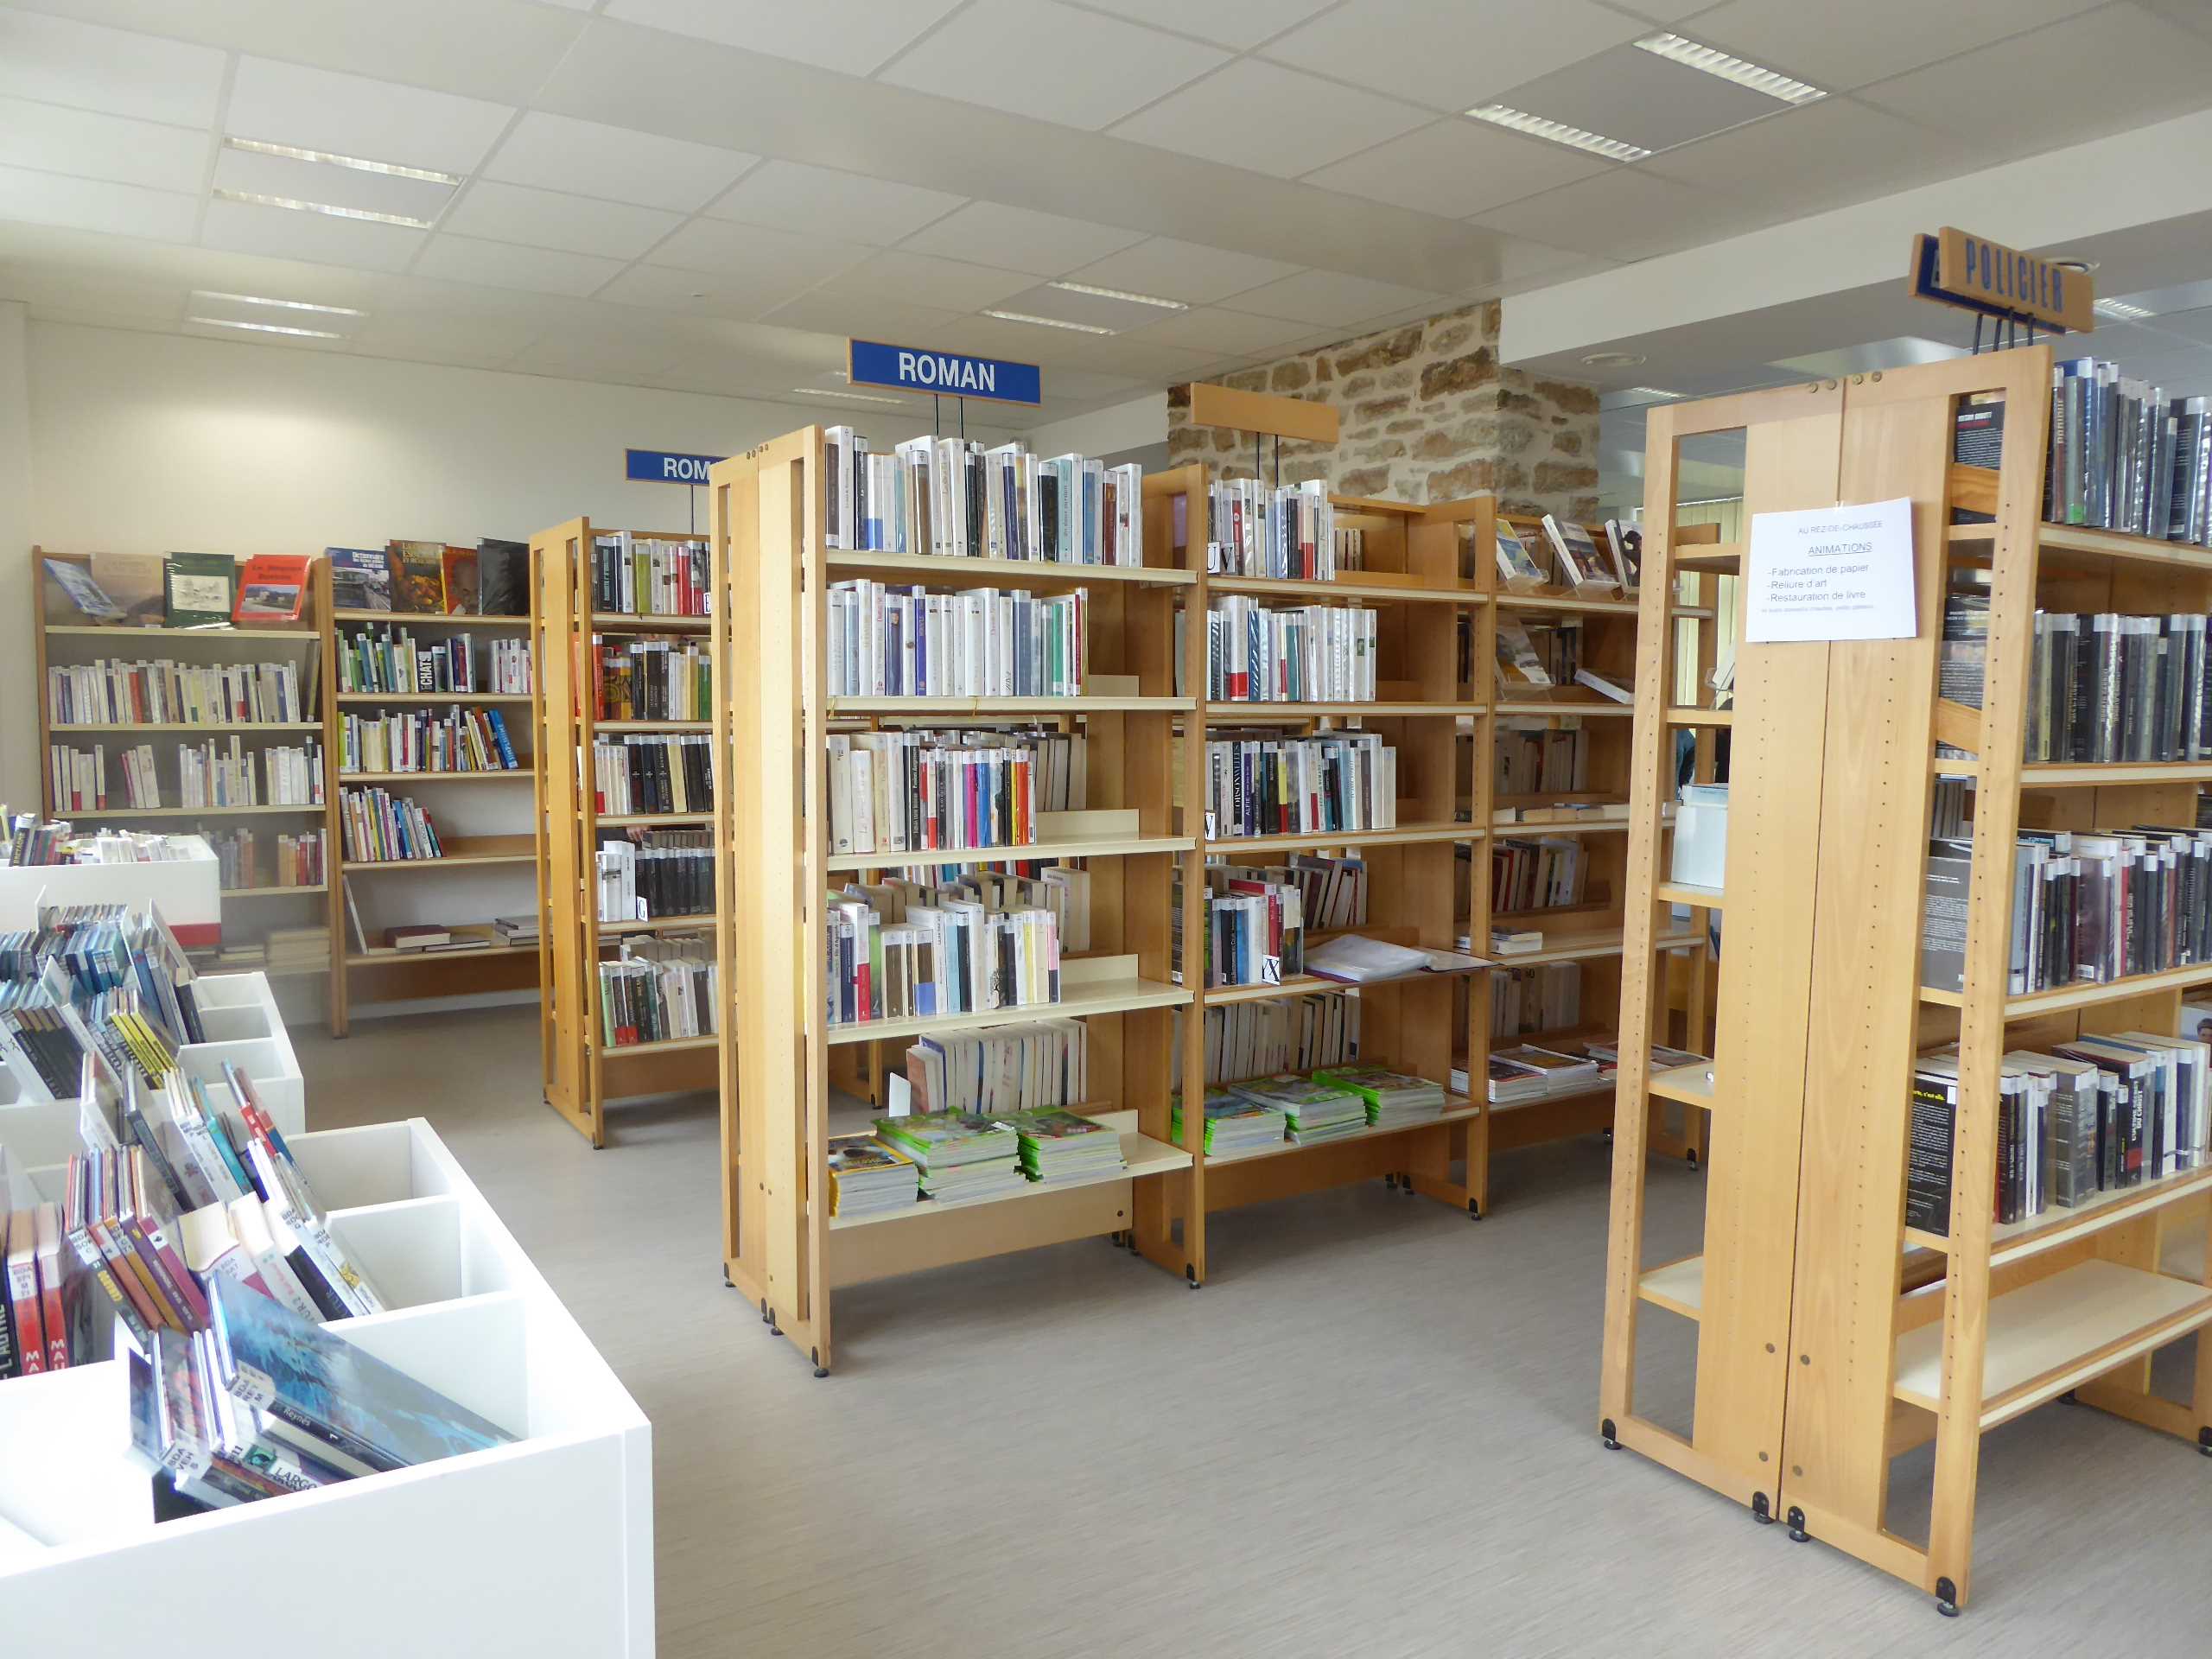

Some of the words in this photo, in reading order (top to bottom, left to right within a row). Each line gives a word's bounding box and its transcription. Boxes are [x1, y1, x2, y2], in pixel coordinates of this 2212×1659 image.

[1965, 238, 2063, 313] POLICIER
[899, 353, 995, 392] ROMAN
[1221, 546, 1233, 570] V
[1808, 542, 1873, 556] ANIMATIONS
[1840, 564, 1869, 574] papier
[420, 657, 433, 685] CHATS
[638, 899, 645, 918] G
[2136, 1117, 2142, 1128] DU
[168, 1447, 186, 1466] BDA
